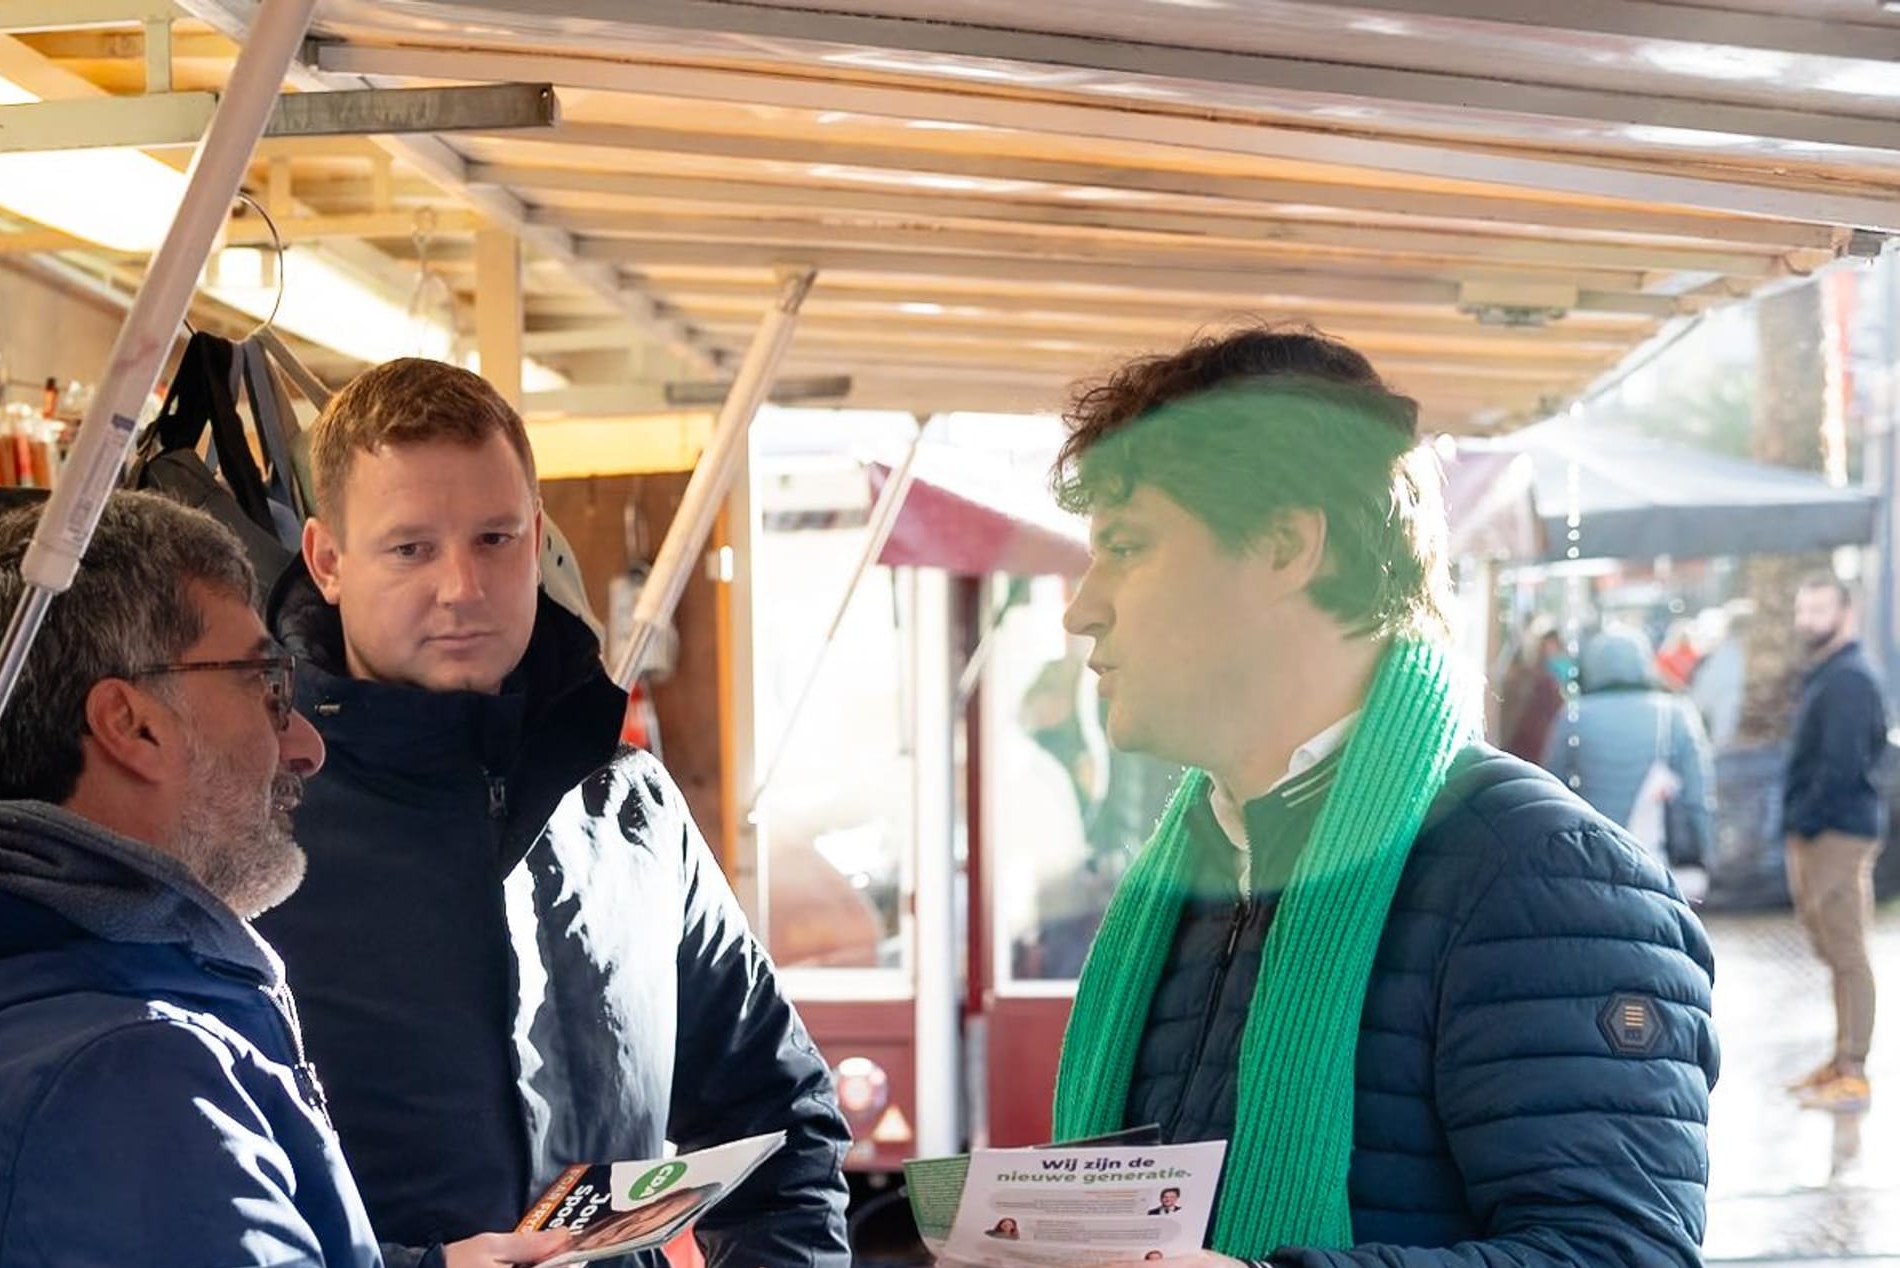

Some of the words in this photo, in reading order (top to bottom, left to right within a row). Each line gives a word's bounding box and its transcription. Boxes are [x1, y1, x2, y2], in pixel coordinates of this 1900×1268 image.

[996, 1171, 1076, 1183] nieuwe
[1083, 1166, 1191, 1184] generatie.
[1042, 1158, 1078, 1172] Wij
[1084, 1158, 1122, 1172] zijn
[1128, 1157, 1155, 1169] de
[639, 1165, 675, 1198] CDA
[545, 1184, 594, 1232] Spoe
